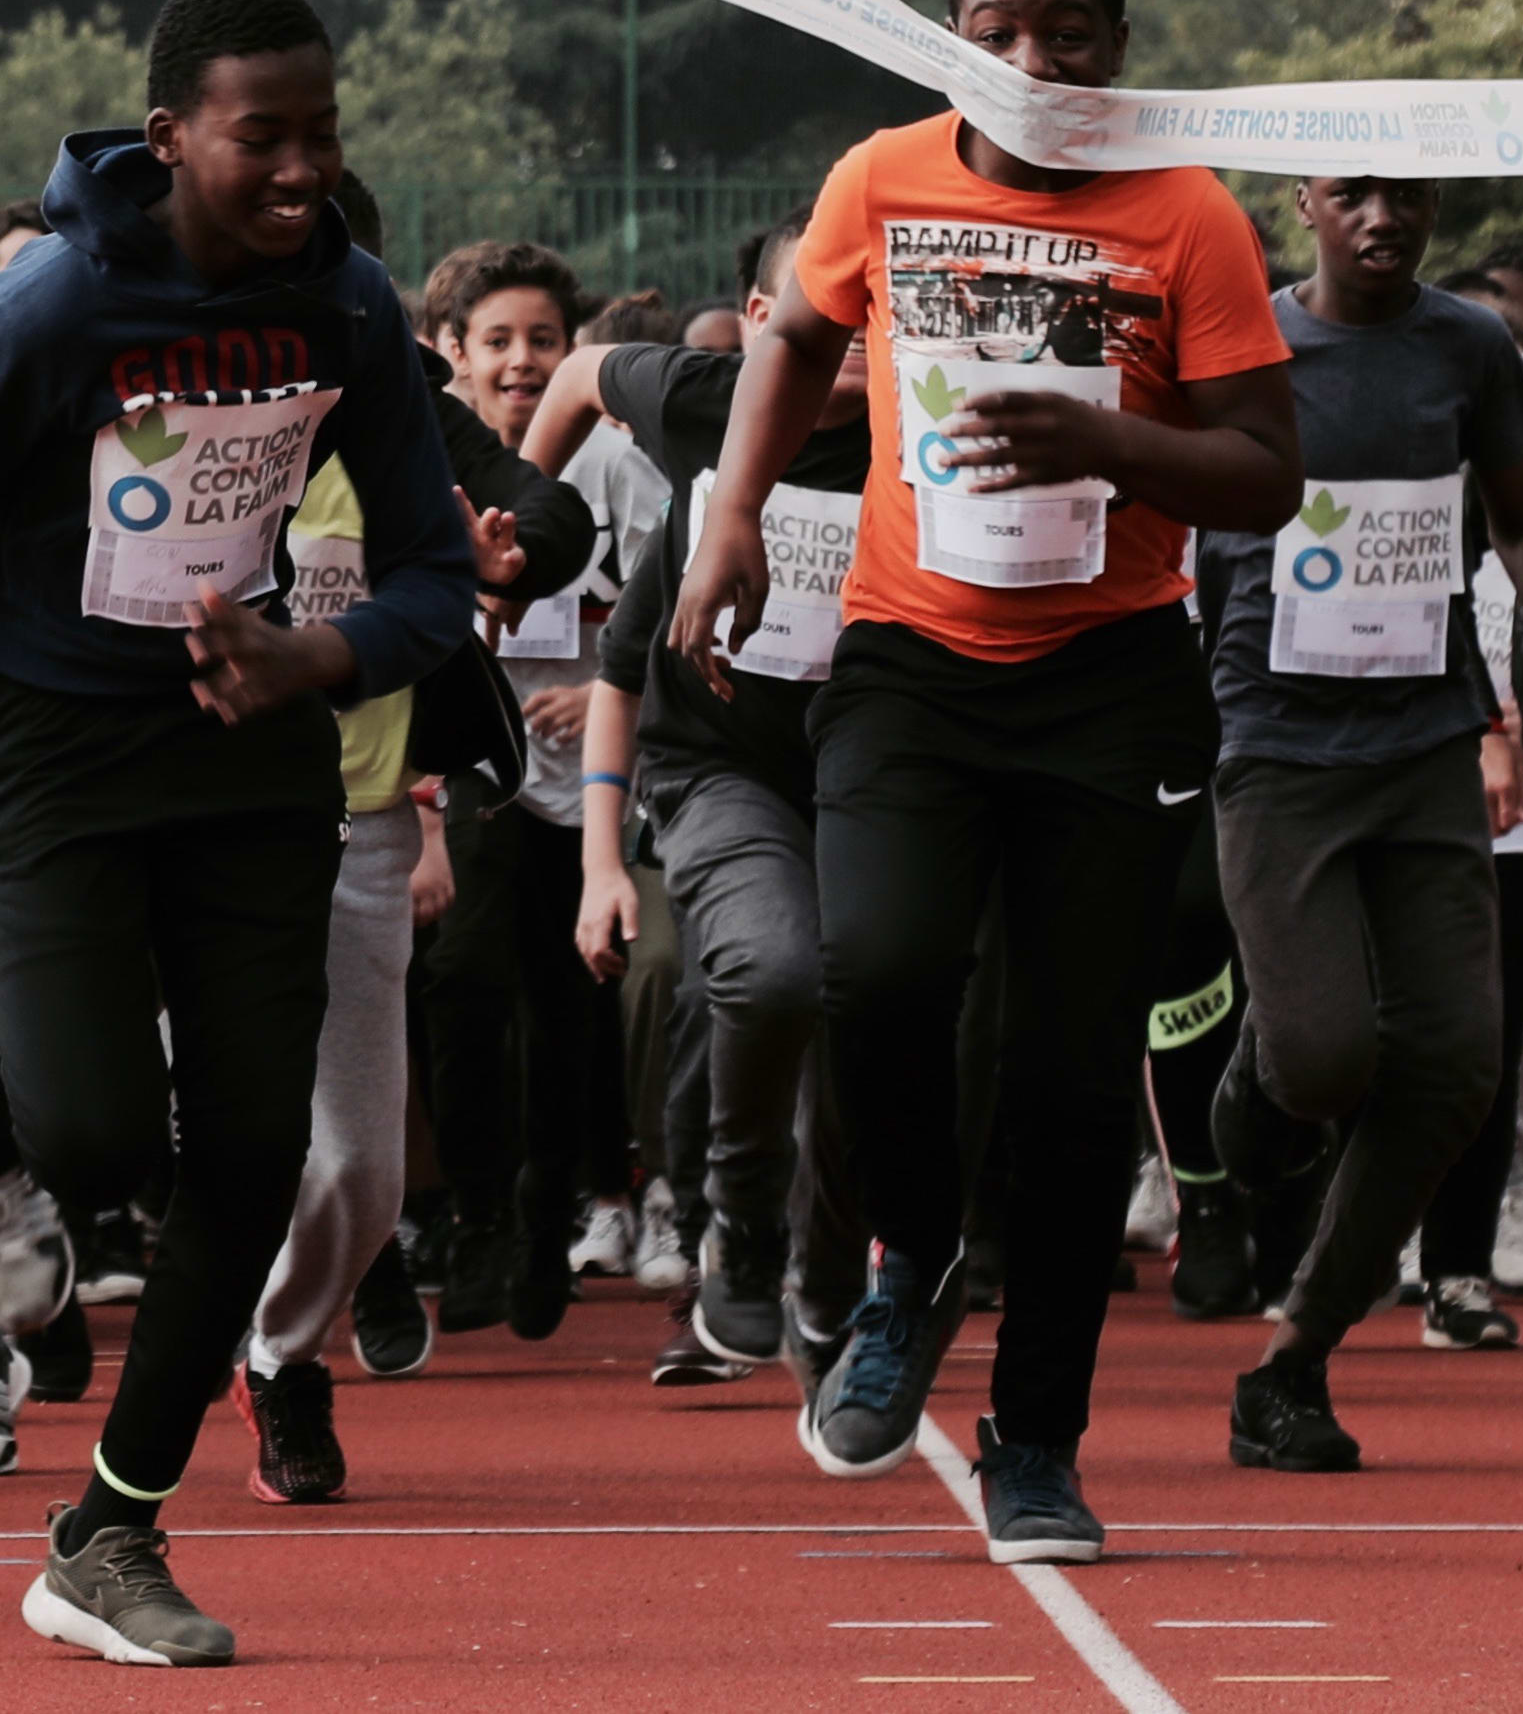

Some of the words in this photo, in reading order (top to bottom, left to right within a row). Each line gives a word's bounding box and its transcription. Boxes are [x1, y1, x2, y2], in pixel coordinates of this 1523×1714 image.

[1046, 236, 1098, 266] UP
[194, 415, 310, 464] ACTION
[190, 442, 300, 494] CONTRE
[184, 500, 226, 526] LA
[232, 468, 290, 521] FAIM
[985, 523, 1024, 537] TOURS
[1358, 506, 1451, 535] ACTION
[764, 538, 851, 571] ONTR
[1356, 532, 1451, 560] CONTRE
[185, 560, 225, 576] TOURS
[297, 566, 367, 589] TION
[793, 569, 845, 595] FAI
[1354, 563, 1385, 586] LA
[1392, 558, 1451, 585] FAIM
[763, 623, 791, 635] OURS
[1351, 624, 1384, 635] TOURS
